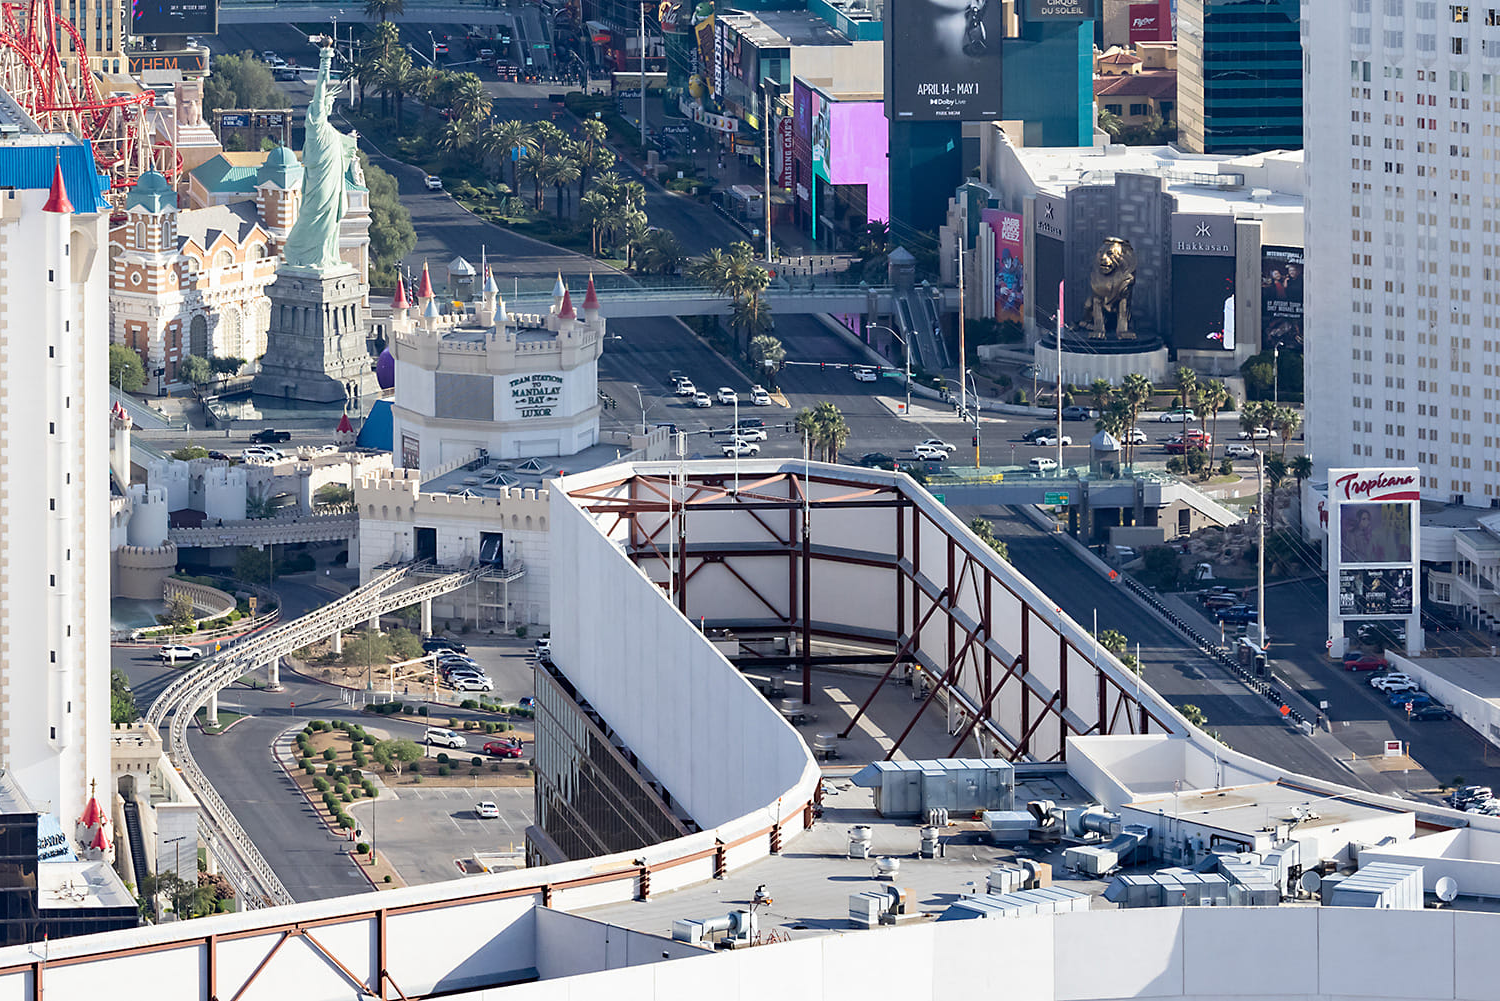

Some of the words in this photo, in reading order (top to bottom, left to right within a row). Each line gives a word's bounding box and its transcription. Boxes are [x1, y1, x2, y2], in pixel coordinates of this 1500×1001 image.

[1041, 7, 1053, 15] DU
[1055, 7, 1084, 15] SOLEIL
[917, 84, 940, 95] APRIL
[941, 84, 950, 95] 14
[956, 84, 974, 94] MAY
[1177, 241, 1229, 252] Hakkasan
[509, 376, 530, 387] TRAM
[531, 375, 563, 383] STATION
[511, 387, 561, 397] MANDALAY
[528, 396, 545, 404] BAY
[522, 408, 552, 418] LUXOR
[1335, 472, 1415, 500] Tropicana
